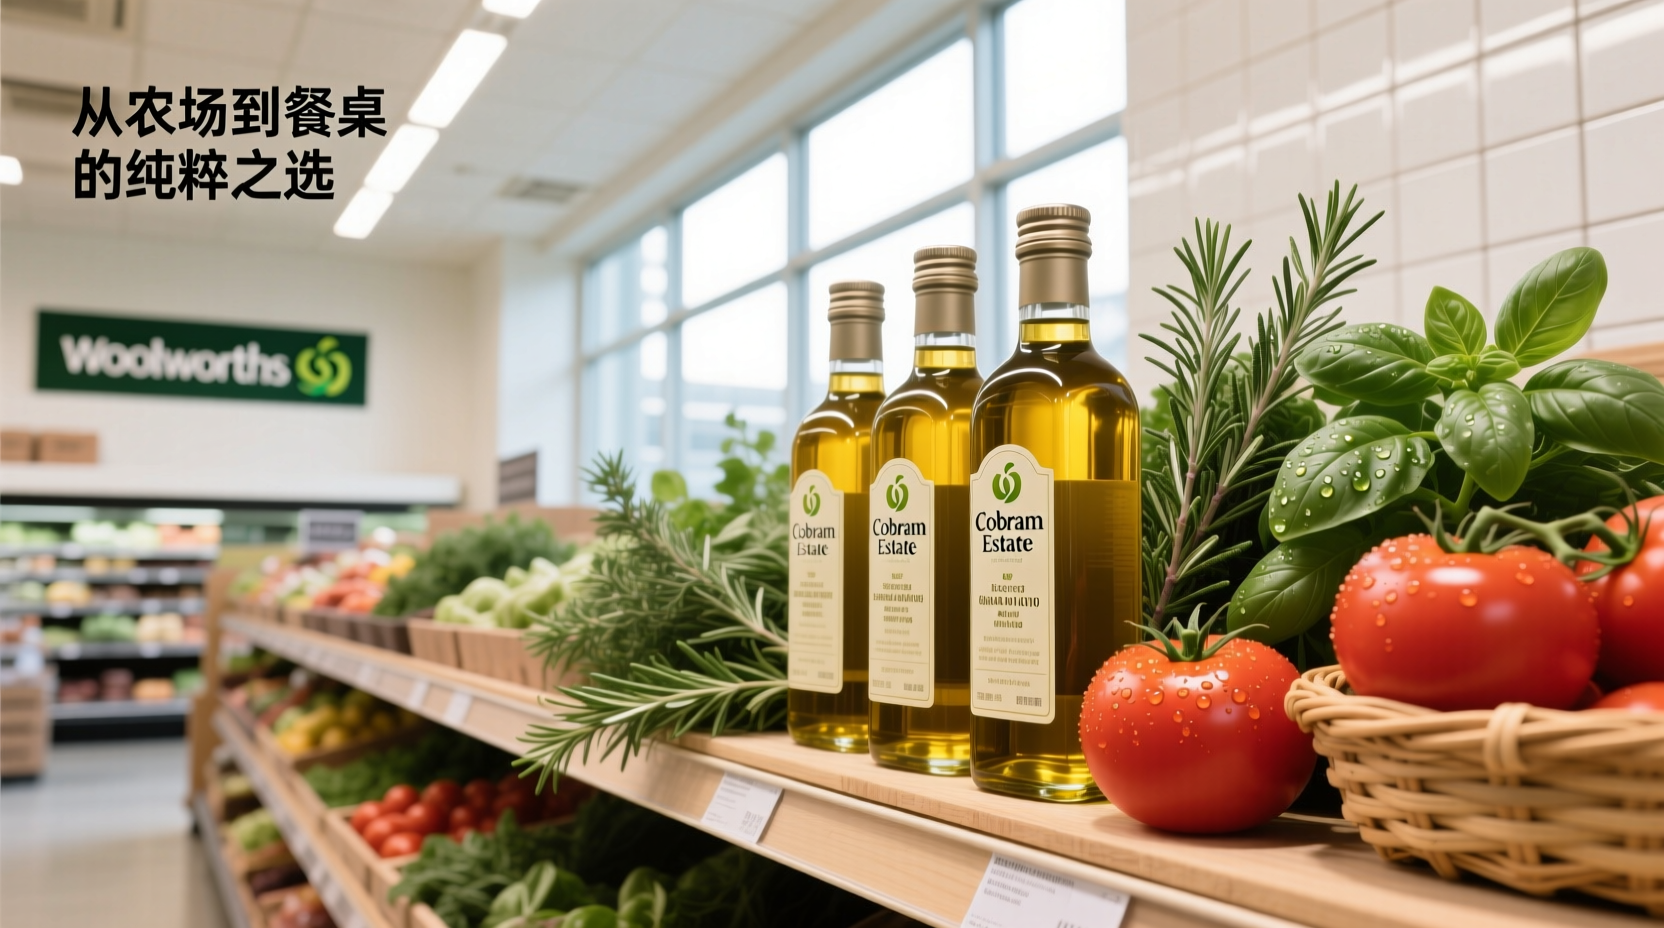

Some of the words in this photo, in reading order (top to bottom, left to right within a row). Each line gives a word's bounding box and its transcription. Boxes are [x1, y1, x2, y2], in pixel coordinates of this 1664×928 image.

[60, 335, 291, 388] Woolworths
[872, 517, 926, 536] Cobram
[975, 510, 1044, 532] Cobram
[878, 538, 917, 555] Estate
[982, 535, 1034, 553] Estate
